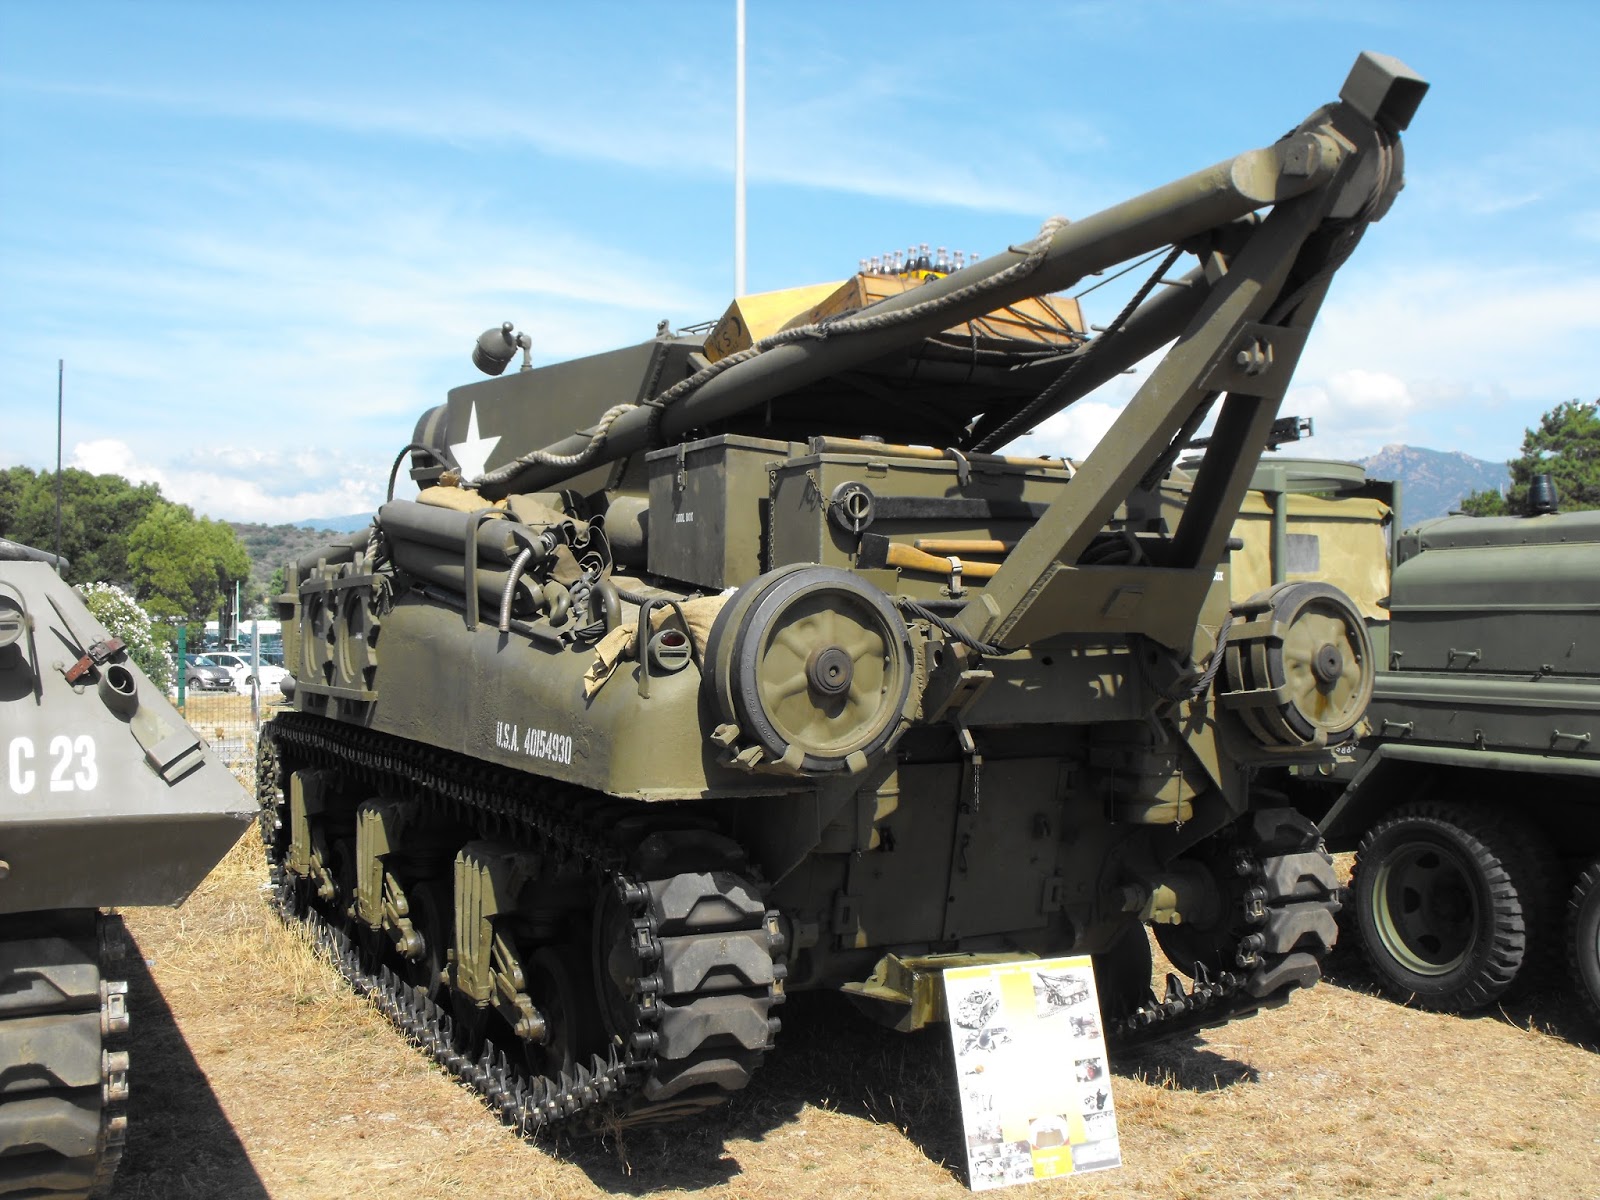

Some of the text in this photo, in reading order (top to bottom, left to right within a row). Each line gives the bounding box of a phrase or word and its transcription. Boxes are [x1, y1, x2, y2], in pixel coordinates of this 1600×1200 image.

[685, 511, 694, 522] BOX
[1213, 571, 1224, 581] OX
[496, 721, 572, 765] U.S.A. 40154930
[1335, 740, 1360, 754] EXPRE
[9, 734, 99, 795] C 23
